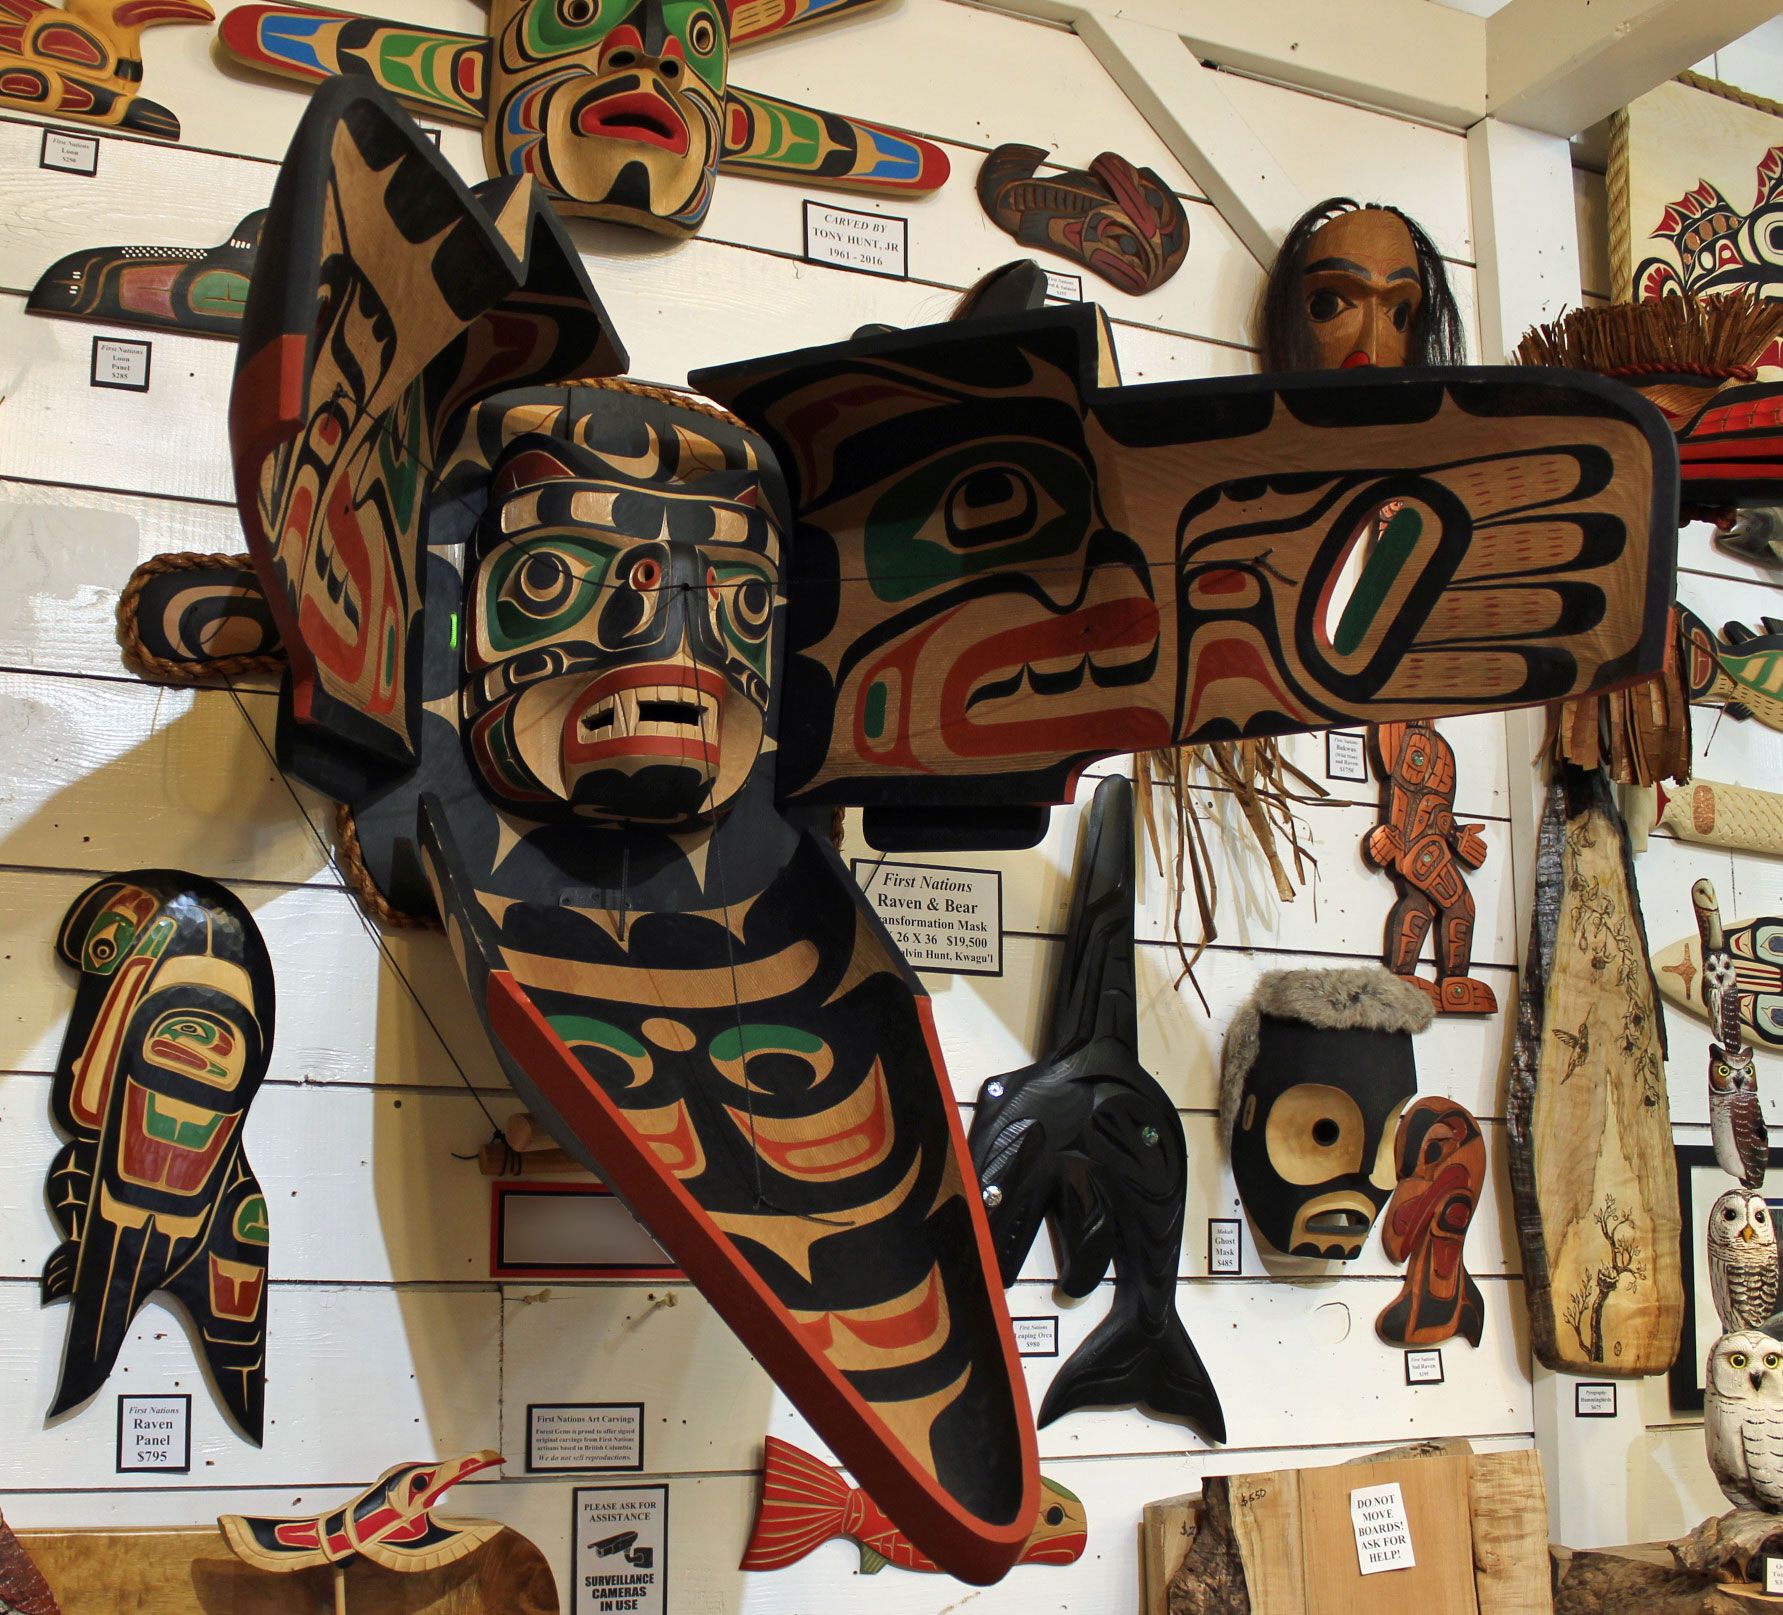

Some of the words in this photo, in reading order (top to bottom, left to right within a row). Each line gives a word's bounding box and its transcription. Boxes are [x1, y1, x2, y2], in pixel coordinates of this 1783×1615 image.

[62, 148, 78, 156] Loon
[824, 214, 869, 230] CARVED
[872, 223, 888, 234] BY
[812, 226, 844, 242] TONY
[848, 235, 882, 250] HUNT,
[885, 242, 899, 252] JR
[829, 248, 850, 260] 1961
[860, 254, 883, 266] 2016
[112, 363, 130, 371] Panel
[883, 872, 916, 888] First
[920, 876, 973, 893] Nations
[877, 893, 922, 910] Raven
[927, 898, 940, 912] &
[945, 899, 978, 914] Bear
[879, 916, 954, 930] ansformation
[958, 920, 988, 932] Mask
[897, 932, 910, 943] 26
[912, 933, 922, 944] X
[925, 934, 938, 945] 36
[946, 936, 988, 949] $19,500
[926, 950, 952, 961] Hunt,
[1214, 1237, 1235, 1245] Ghost
[128, 1406, 147, 1414] First
[149, 1406, 180, 1414] Nations
[134, 1418, 173, 1430] Raven
[602, 1415, 635, 1424] Carvings
[136, 1434, 170, 1446] Panel
[137, 1450, 168, 1462] $795
[1357, 1498, 1372, 1509] DO
[1374, 1494, 1395, 1506] NOT
[589, 1512, 651, 1522] ASSISTANCE
[1363, 1509, 1394, 1522] MOVE
[1358, 1521, 1404, 1536] BOARDS!
[1361, 1539, 1381, 1550] ASK
[1384, 1535, 1406, 1546] FOR
[1369, 1550, 1401, 1563] HELP!
[585, 1574, 654, 1587] SURVEILLANCE
[592, 1586, 647, 1599] CAMERAS
[600, 1601, 612, 1612] IN
[616, 1599, 638, 1610] USE
